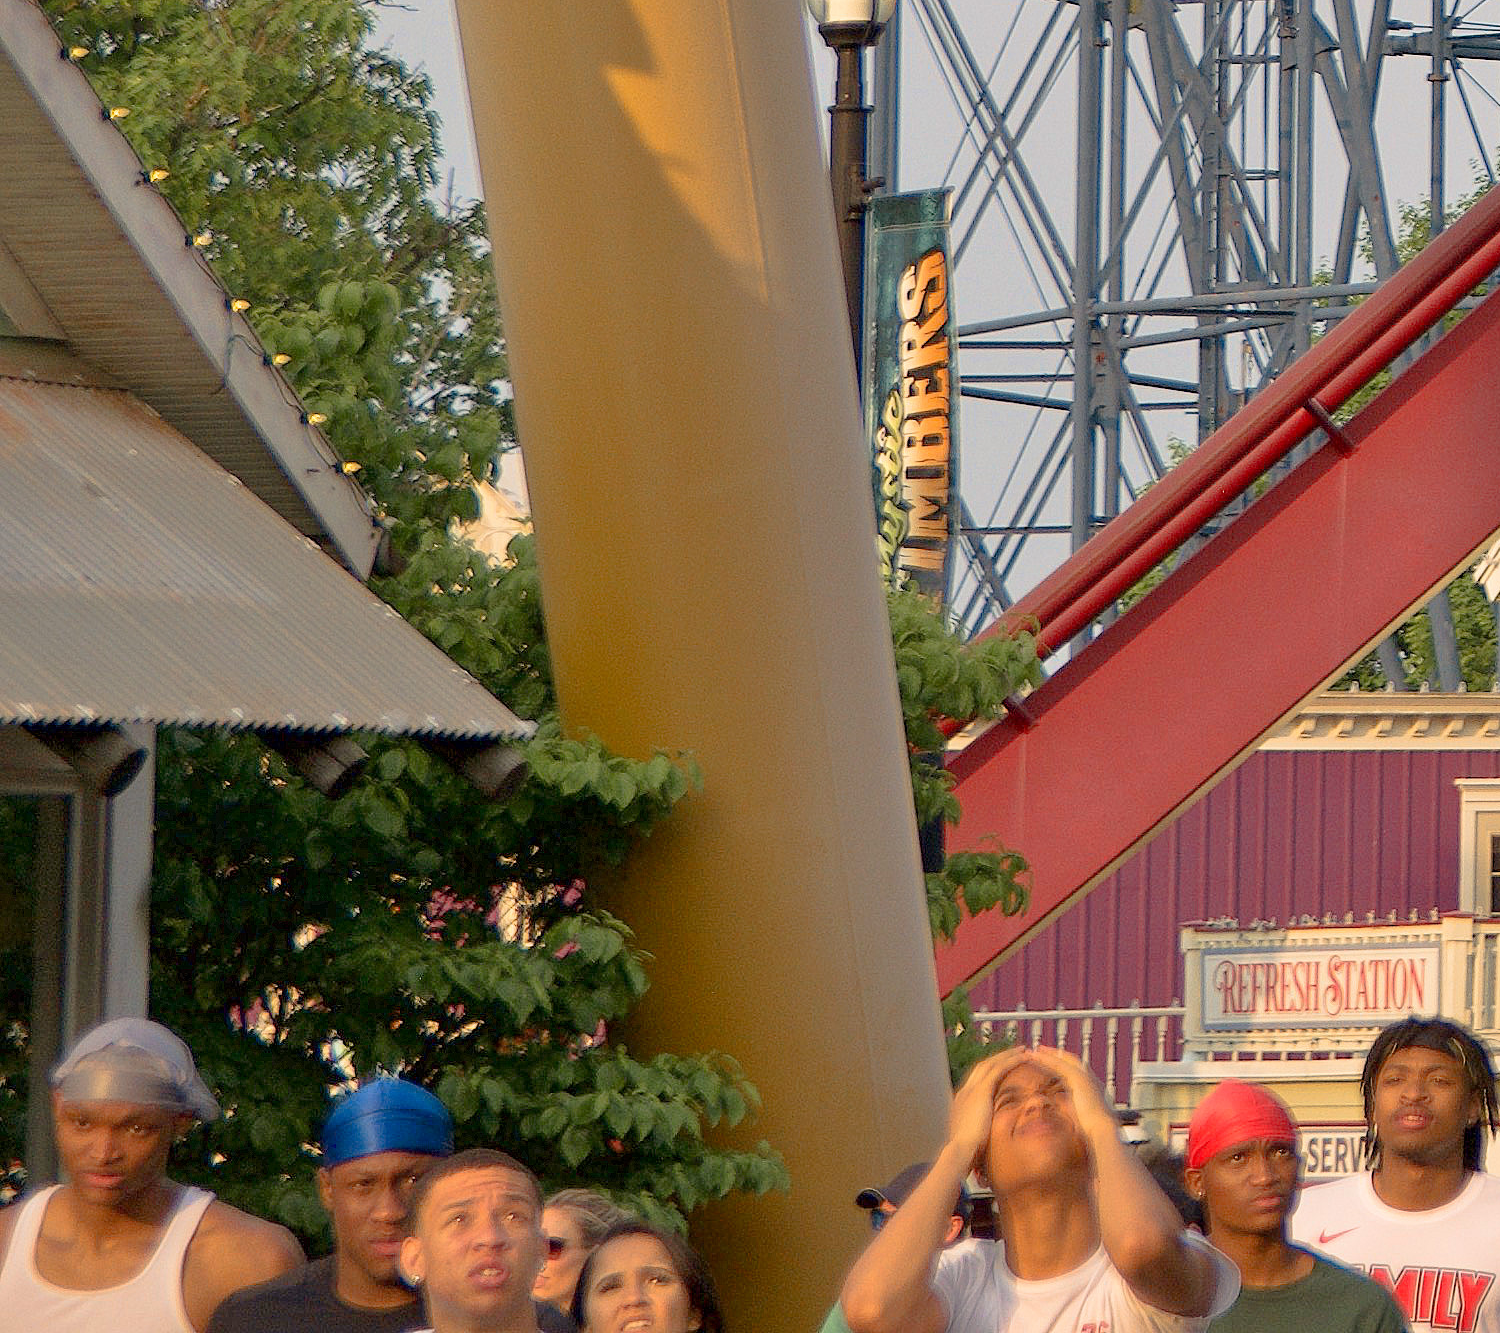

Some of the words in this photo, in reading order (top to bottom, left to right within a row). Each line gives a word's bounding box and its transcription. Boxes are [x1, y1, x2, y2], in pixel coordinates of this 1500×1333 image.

[896, 249, 950, 613] IMBERS
[1214, 960, 1320, 1013] REFRESH
[1324, 955, 1427, 1015] STATION
